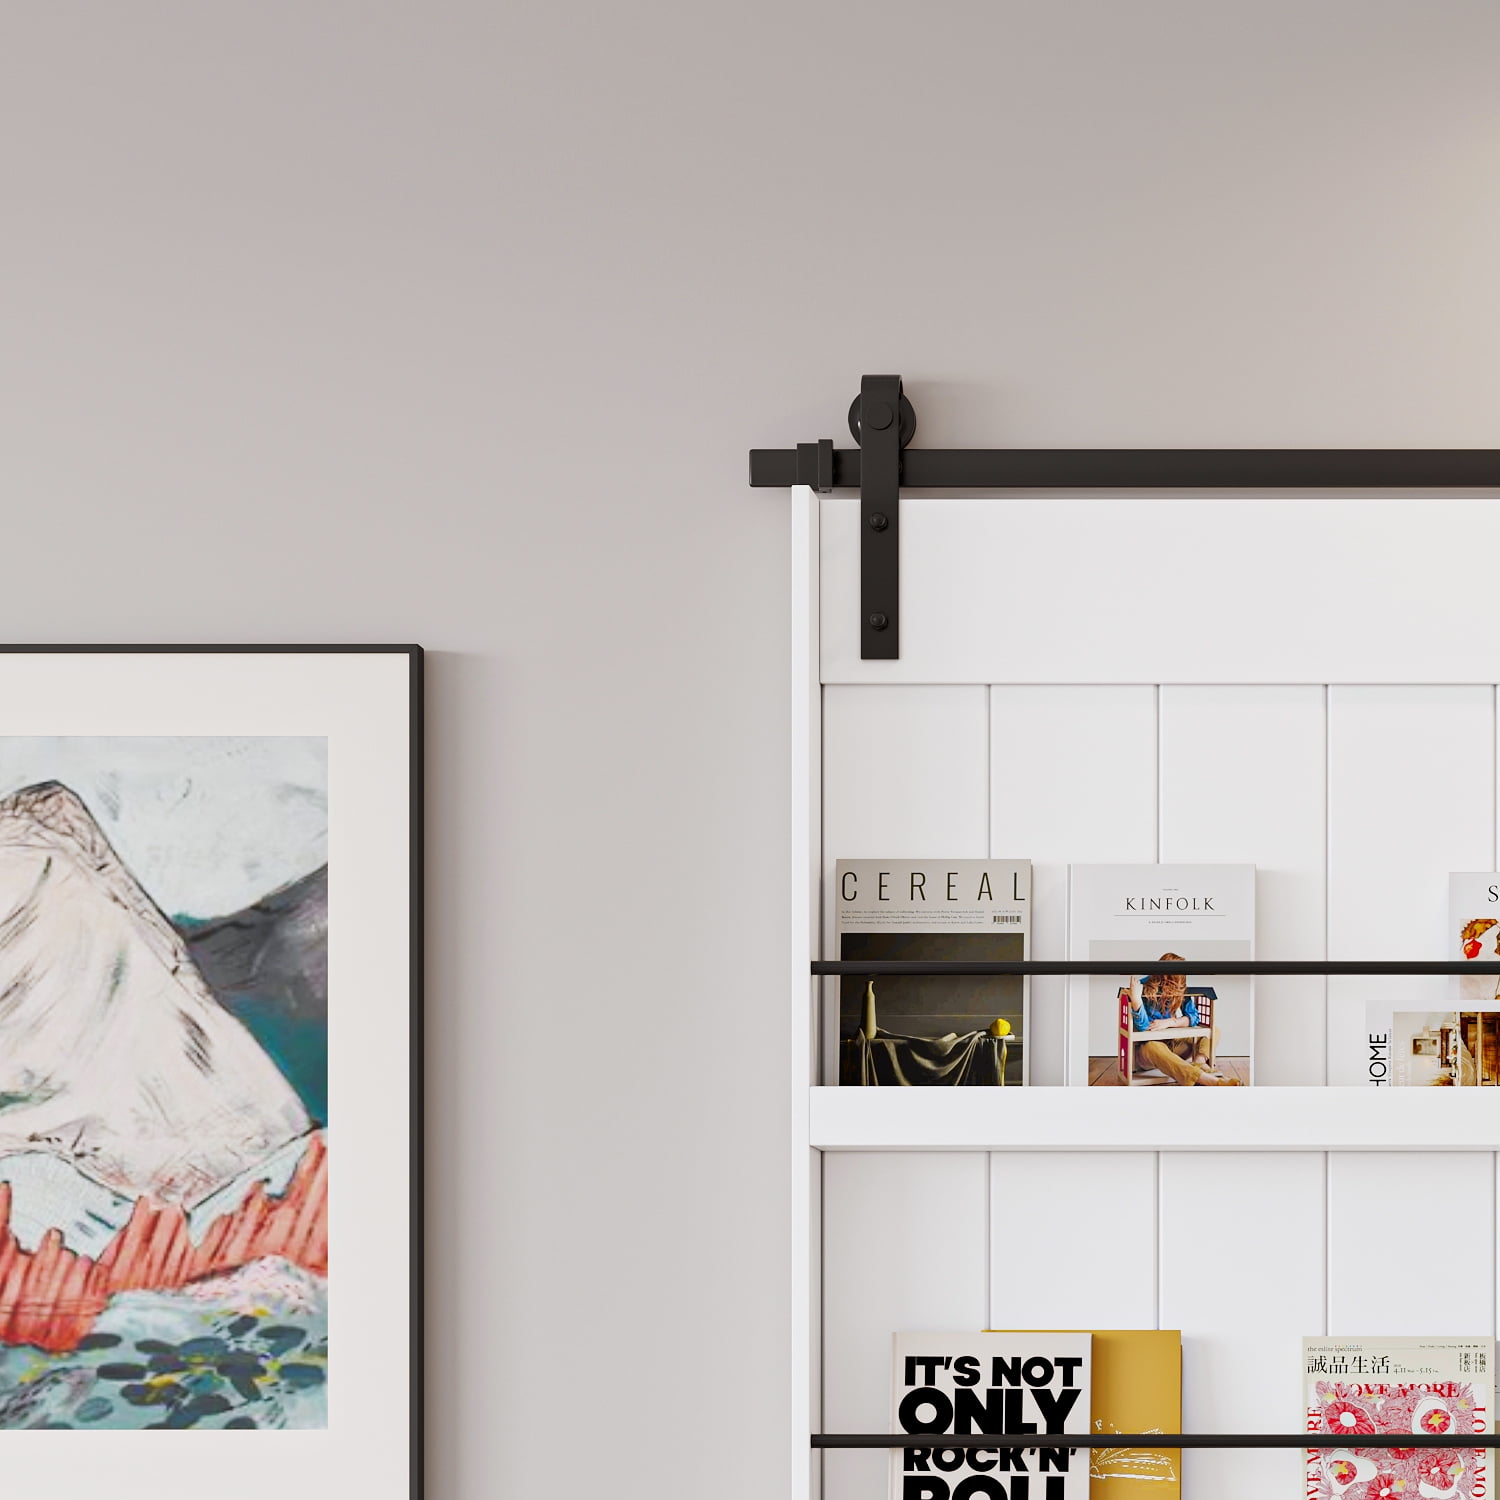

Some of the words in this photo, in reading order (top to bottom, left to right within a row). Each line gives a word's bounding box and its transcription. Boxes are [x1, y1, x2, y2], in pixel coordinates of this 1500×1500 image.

[842, 872, 1025, 901] CEREAL
[1126, 897, 1215, 911] KINFOLK
[1369, 1033, 1387, 1086] HOME
[904, 1355, 982, 1387] IT'S
[991, 1355, 1083, 1387] NOT
[1307, 1355, 1390, 1374] 誠品生活
[898, 1387, 1082, 1435] ONLY
[1306, 1406, 1322, 1464] MRE
[1470, 1406, 1487, 1464] LOE
